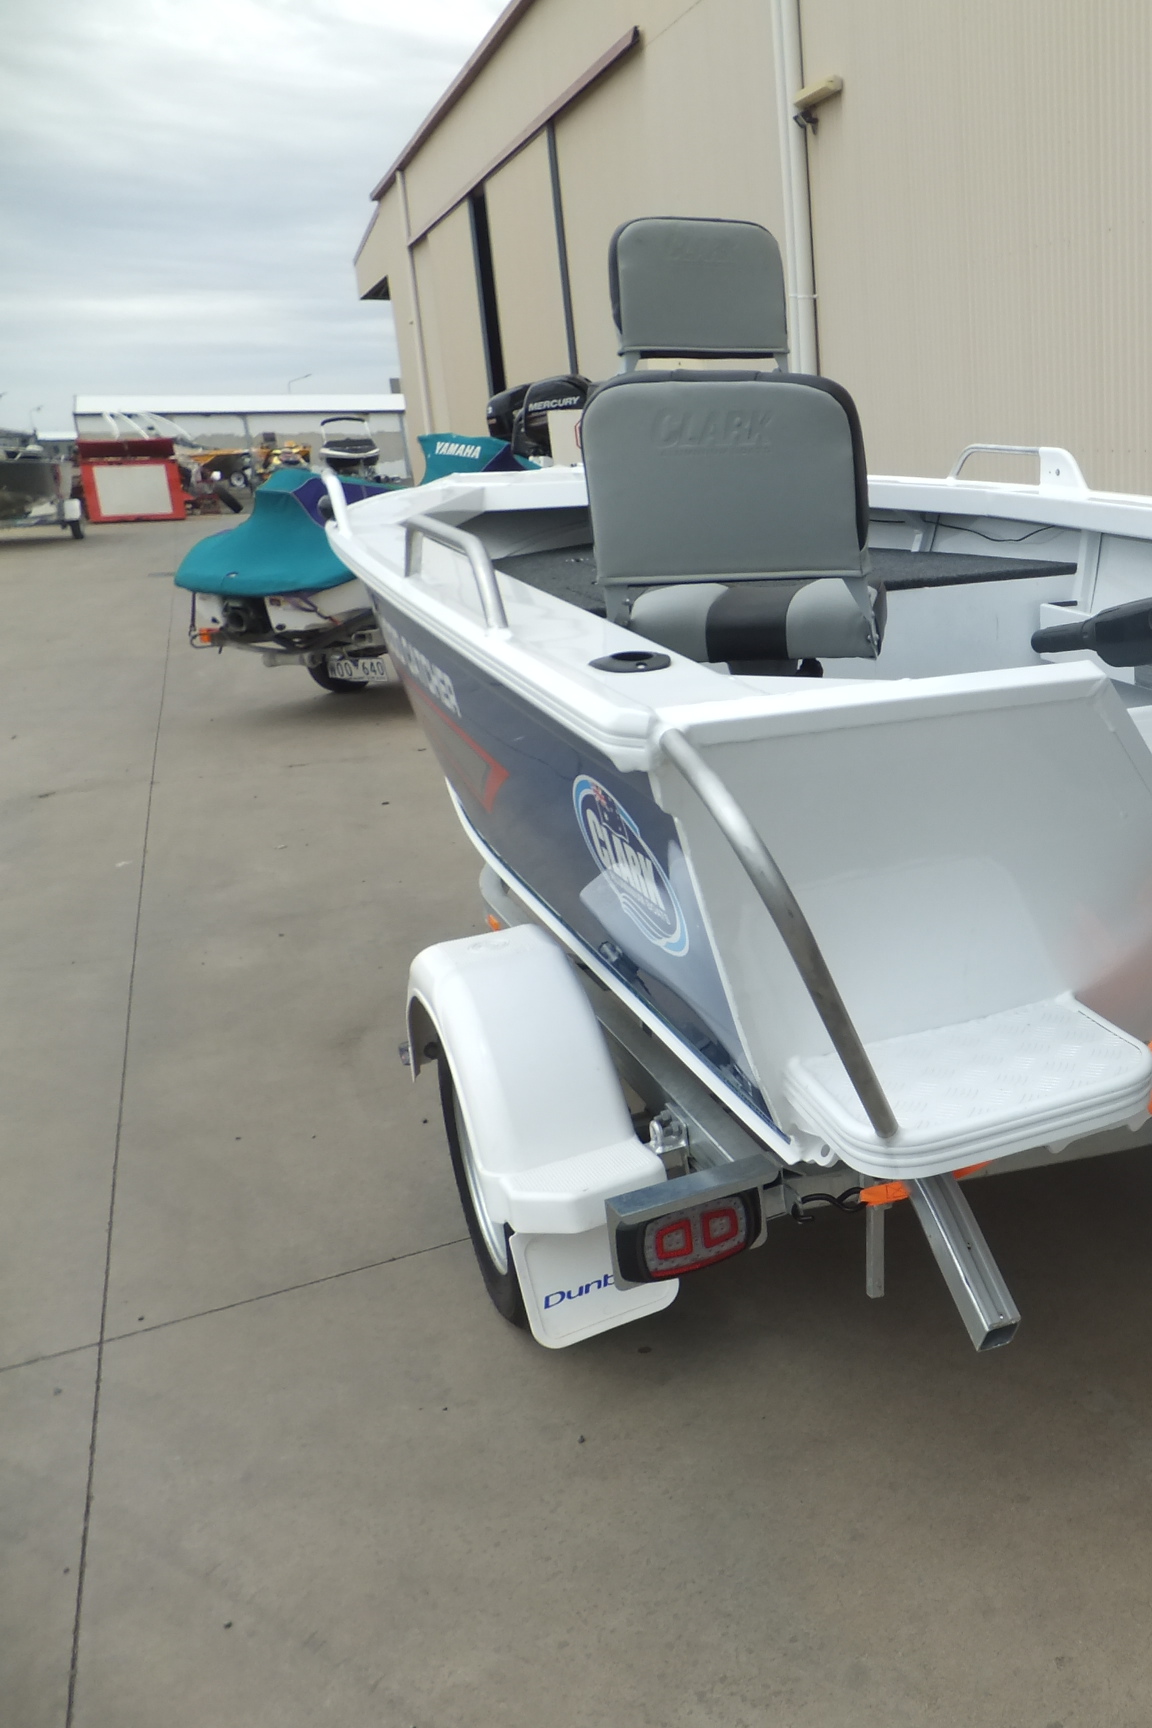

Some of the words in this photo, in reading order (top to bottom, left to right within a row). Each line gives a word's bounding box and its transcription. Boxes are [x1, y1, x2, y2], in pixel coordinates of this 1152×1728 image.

[528, 396, 580, 412] MERCURY
[652, 407, 775, 450] CLARK
[434, 441, 482, 459] YAMAHA
[361, 661, 384, 676] 640
[586, 807, 666, 912] CLARK
[544, 1273, 615, 1309] Dunb
